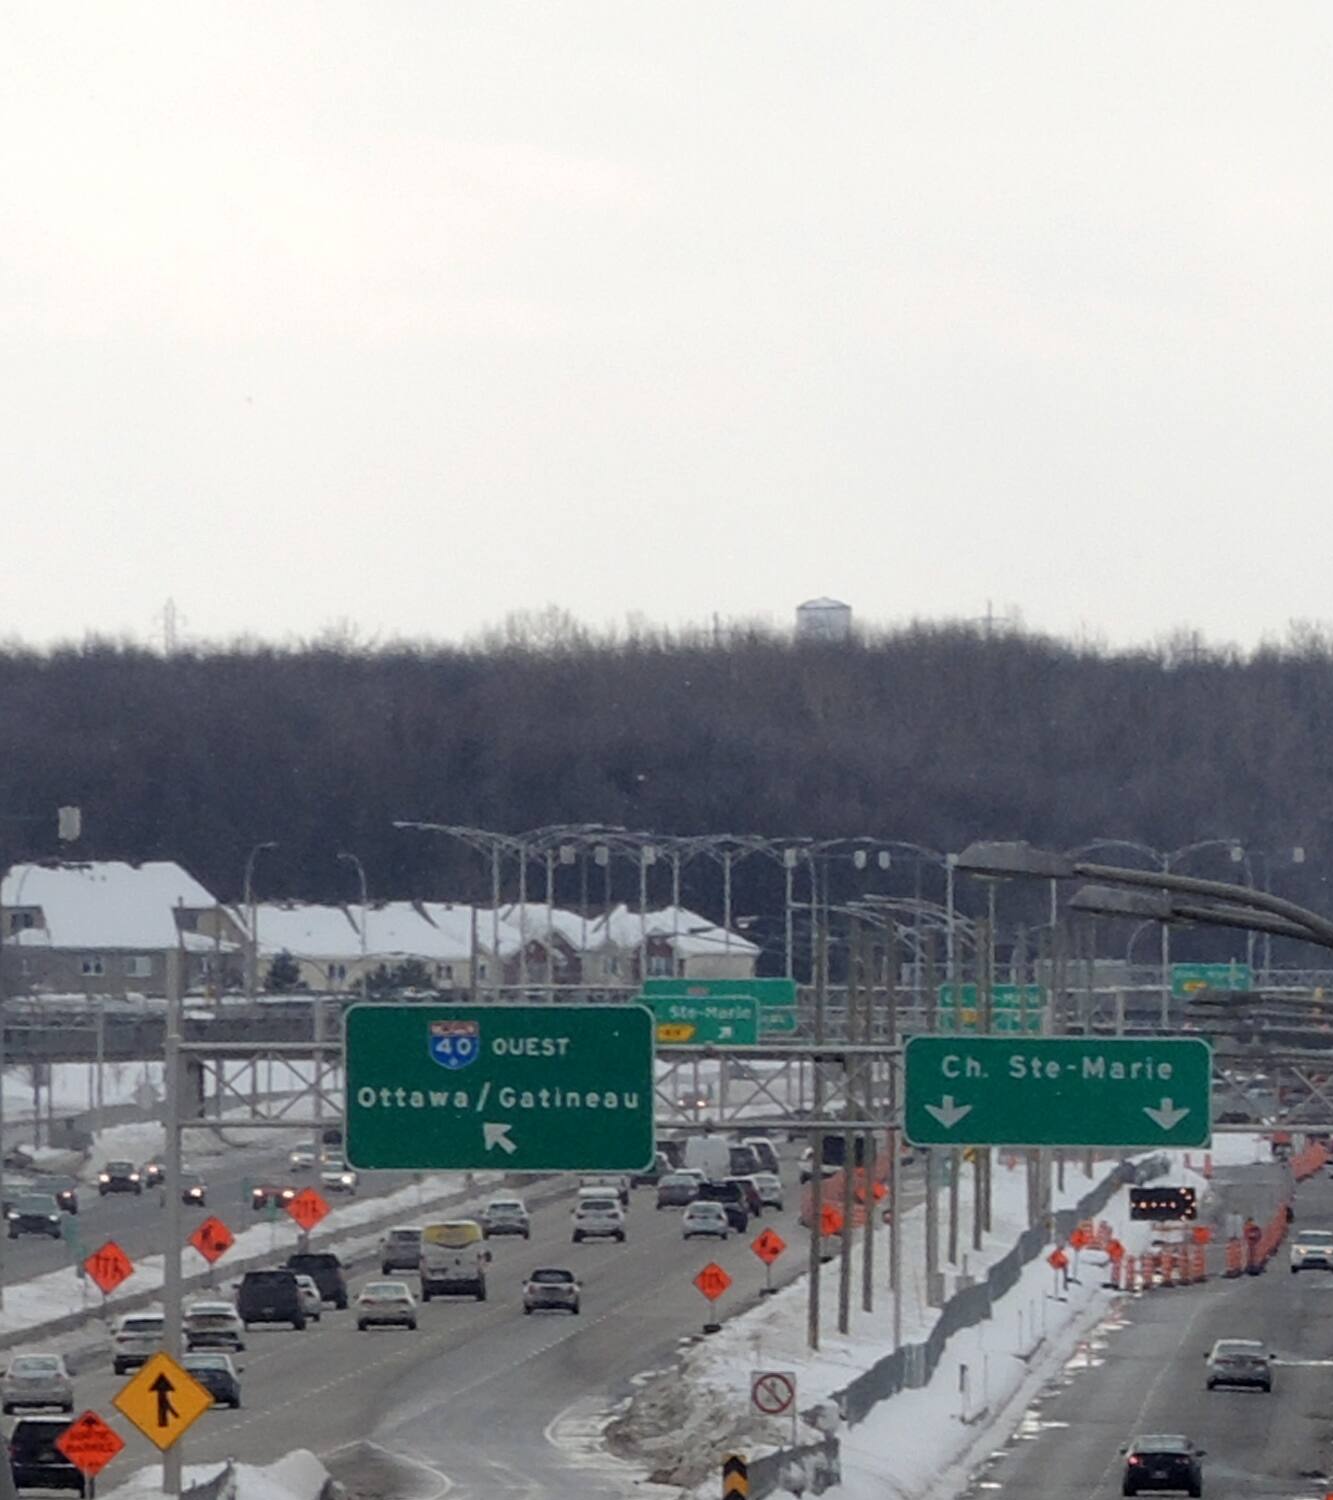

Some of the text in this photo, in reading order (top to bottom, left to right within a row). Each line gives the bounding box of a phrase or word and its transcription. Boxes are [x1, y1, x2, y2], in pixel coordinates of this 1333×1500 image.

[668, 1004, 752, 1021] Ste-Marie
[435, 1036, 571, 1057] 40 OUEST
[941, 1055, 1174, 1080] Ch. Ste-Marie
